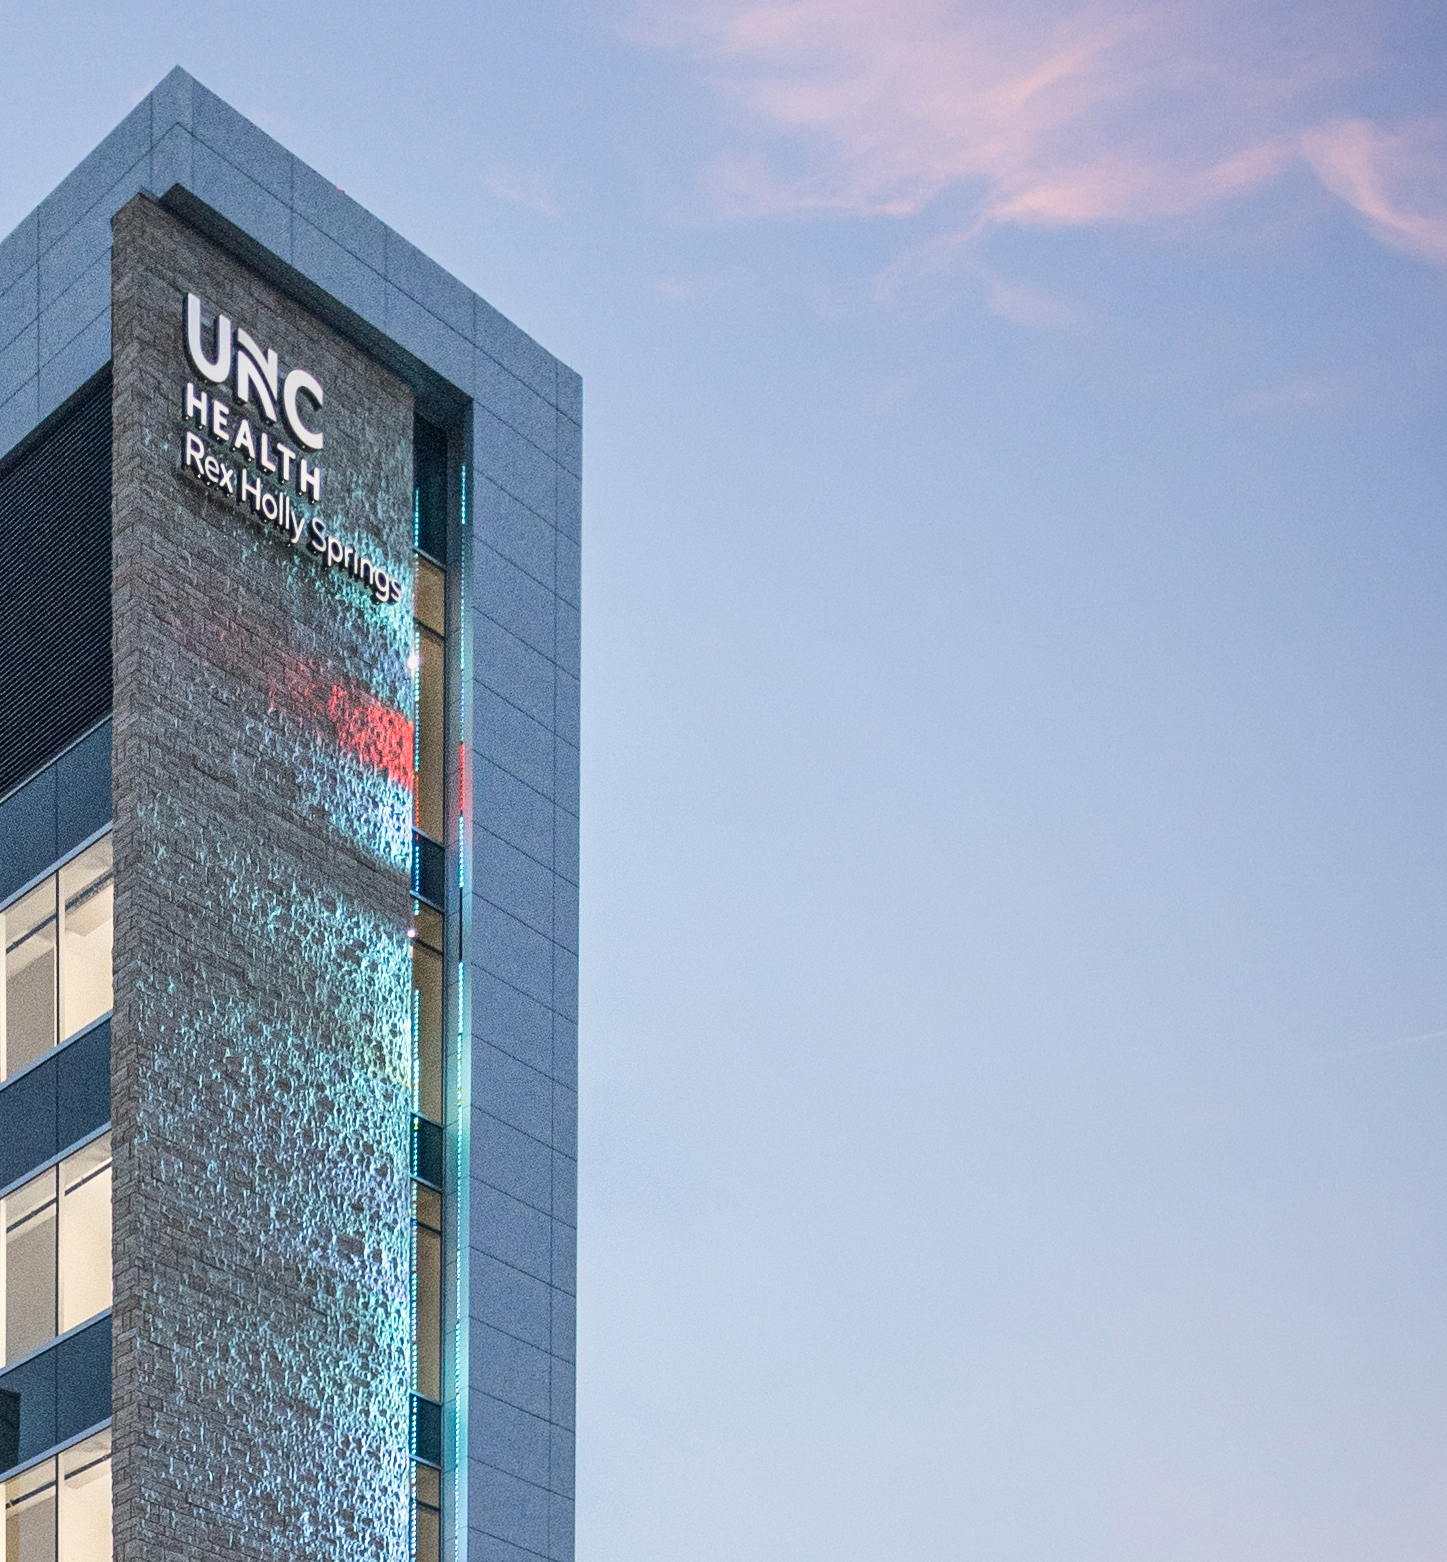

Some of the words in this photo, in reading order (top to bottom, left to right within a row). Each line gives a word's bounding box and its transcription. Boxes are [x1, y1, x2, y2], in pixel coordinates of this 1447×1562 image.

[186, 382, 320, 501] HEALTH
[187, 292, 323, 450] UNC
[186, 432, 234, 494] Rex
[241, 468, 306, 543] Holly
[311, 517, 402, 602] Springs
